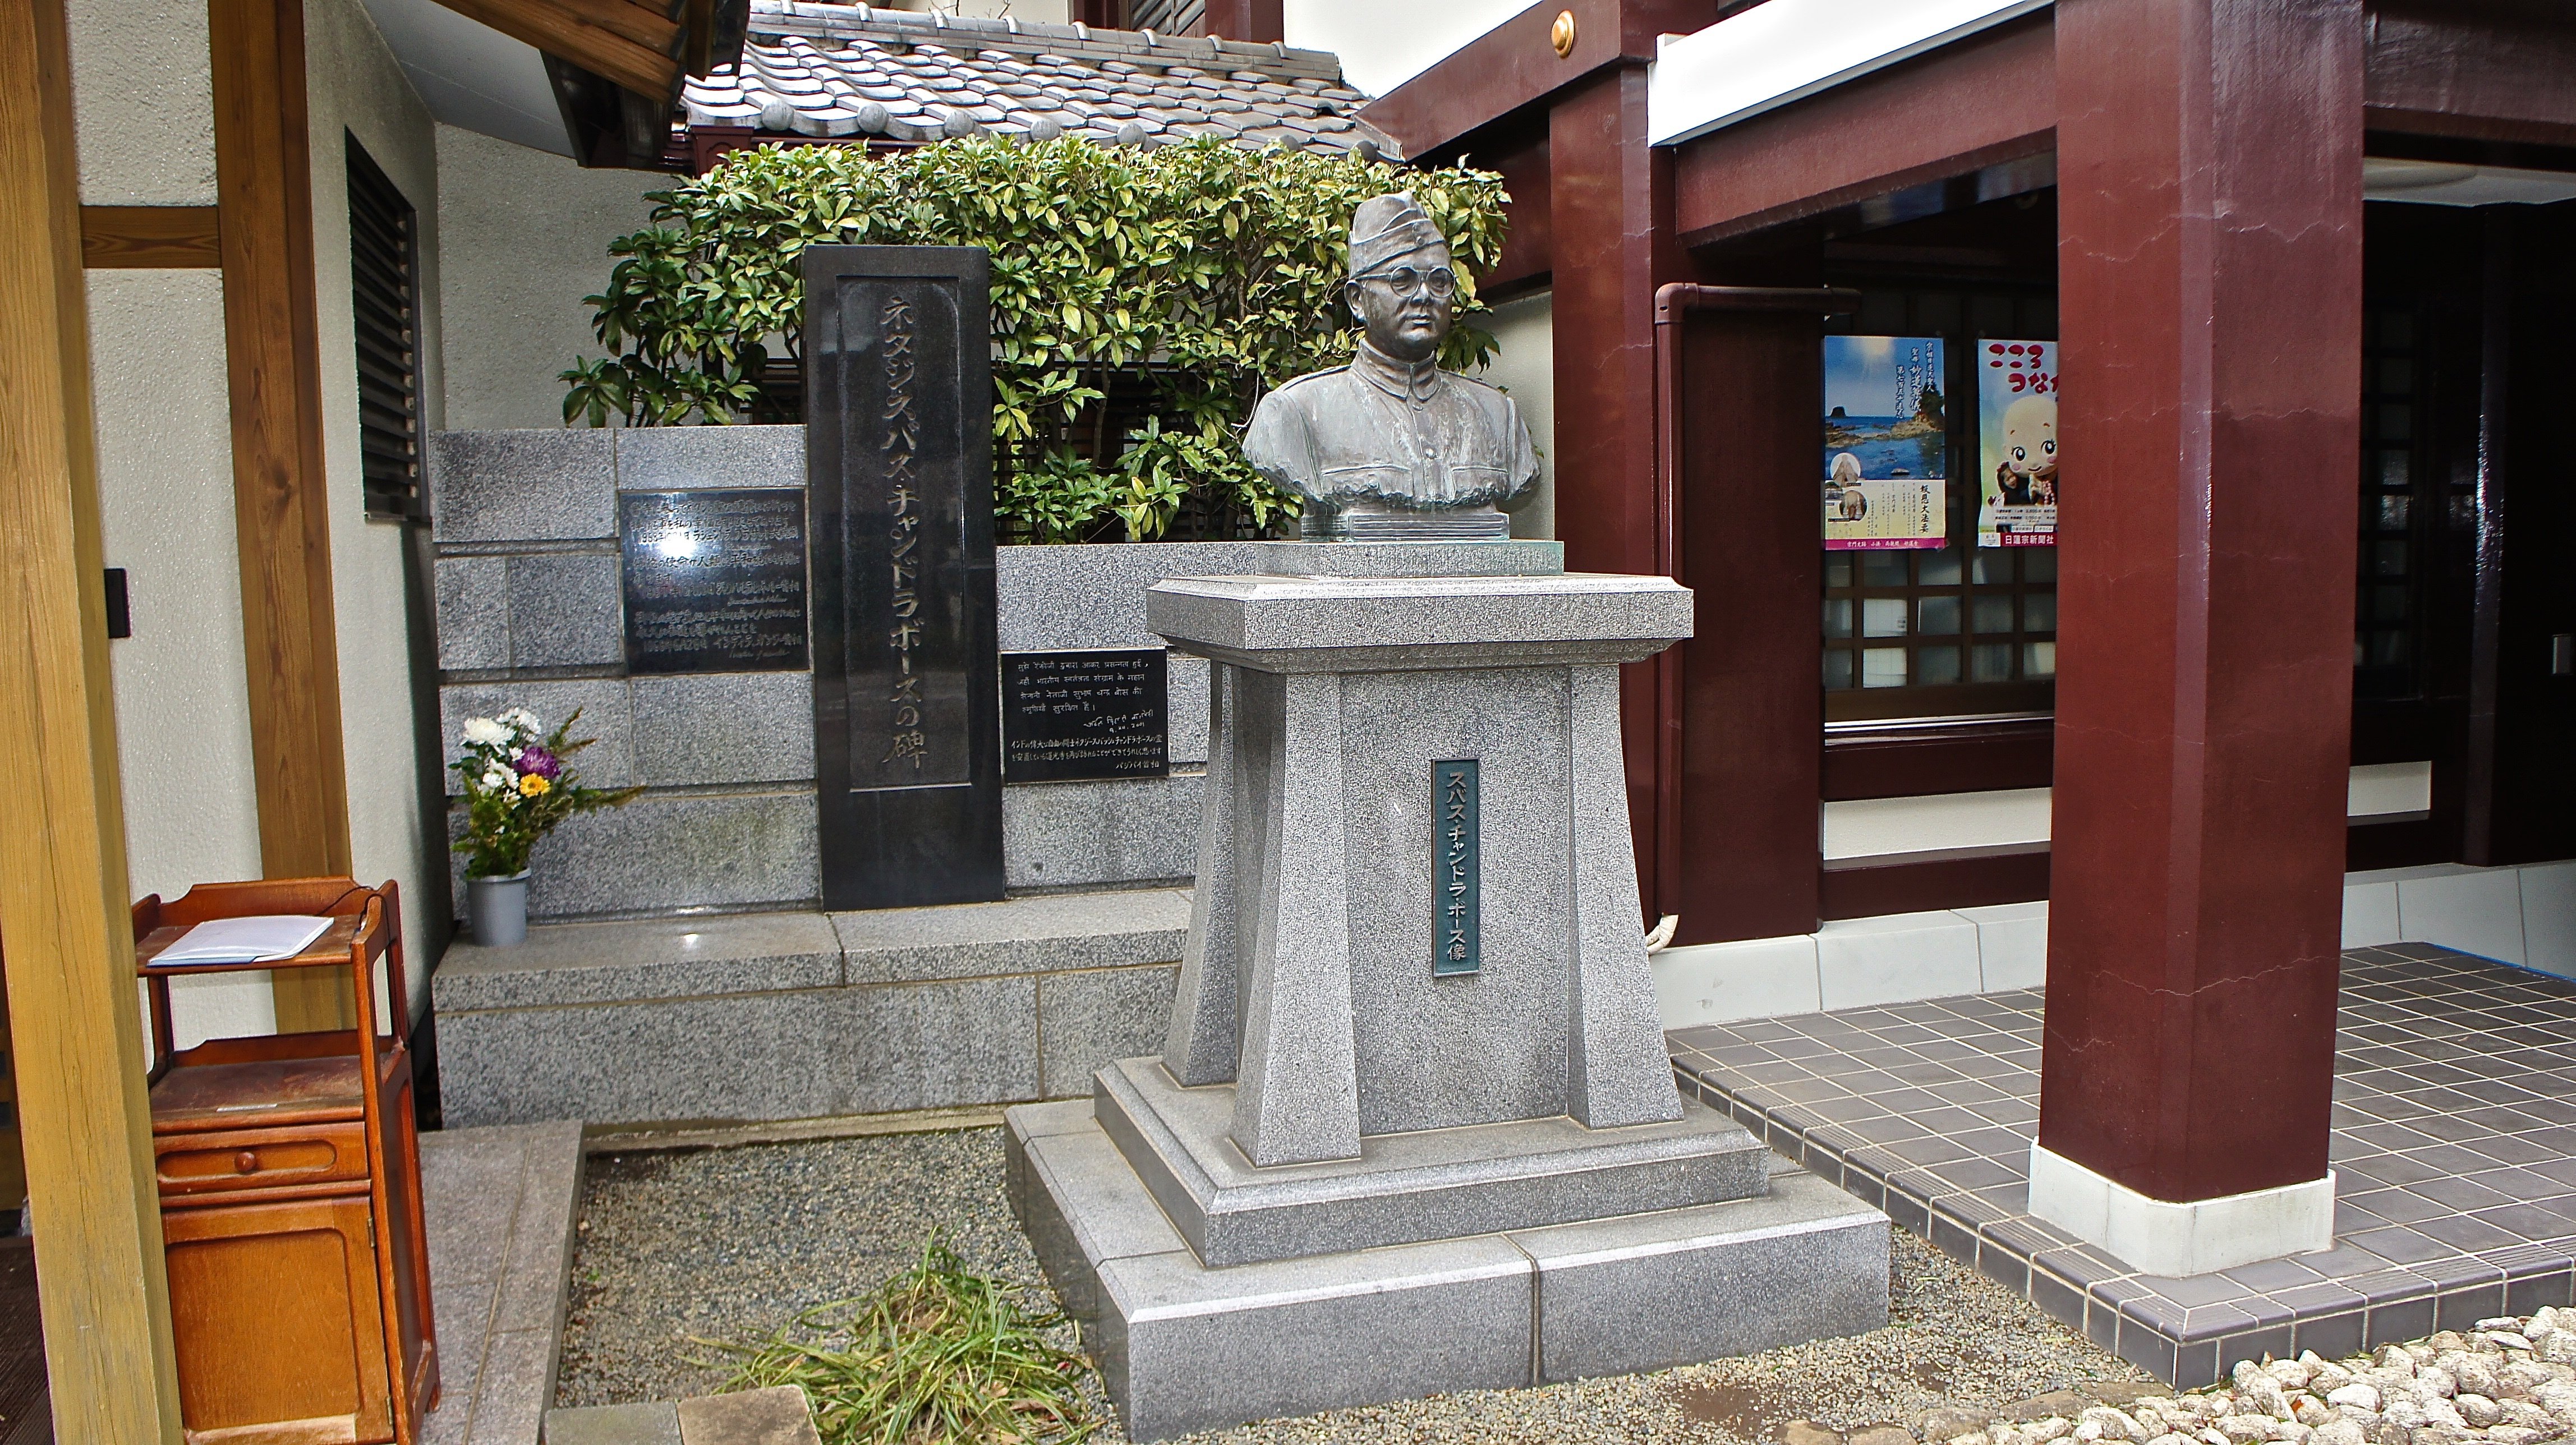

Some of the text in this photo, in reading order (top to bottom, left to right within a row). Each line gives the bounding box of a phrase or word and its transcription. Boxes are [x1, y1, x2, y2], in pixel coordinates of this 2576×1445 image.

[1989, 343, 2044, 369] こころ
[2005, 535, 2054, 545] 日蓮宗新聞社
